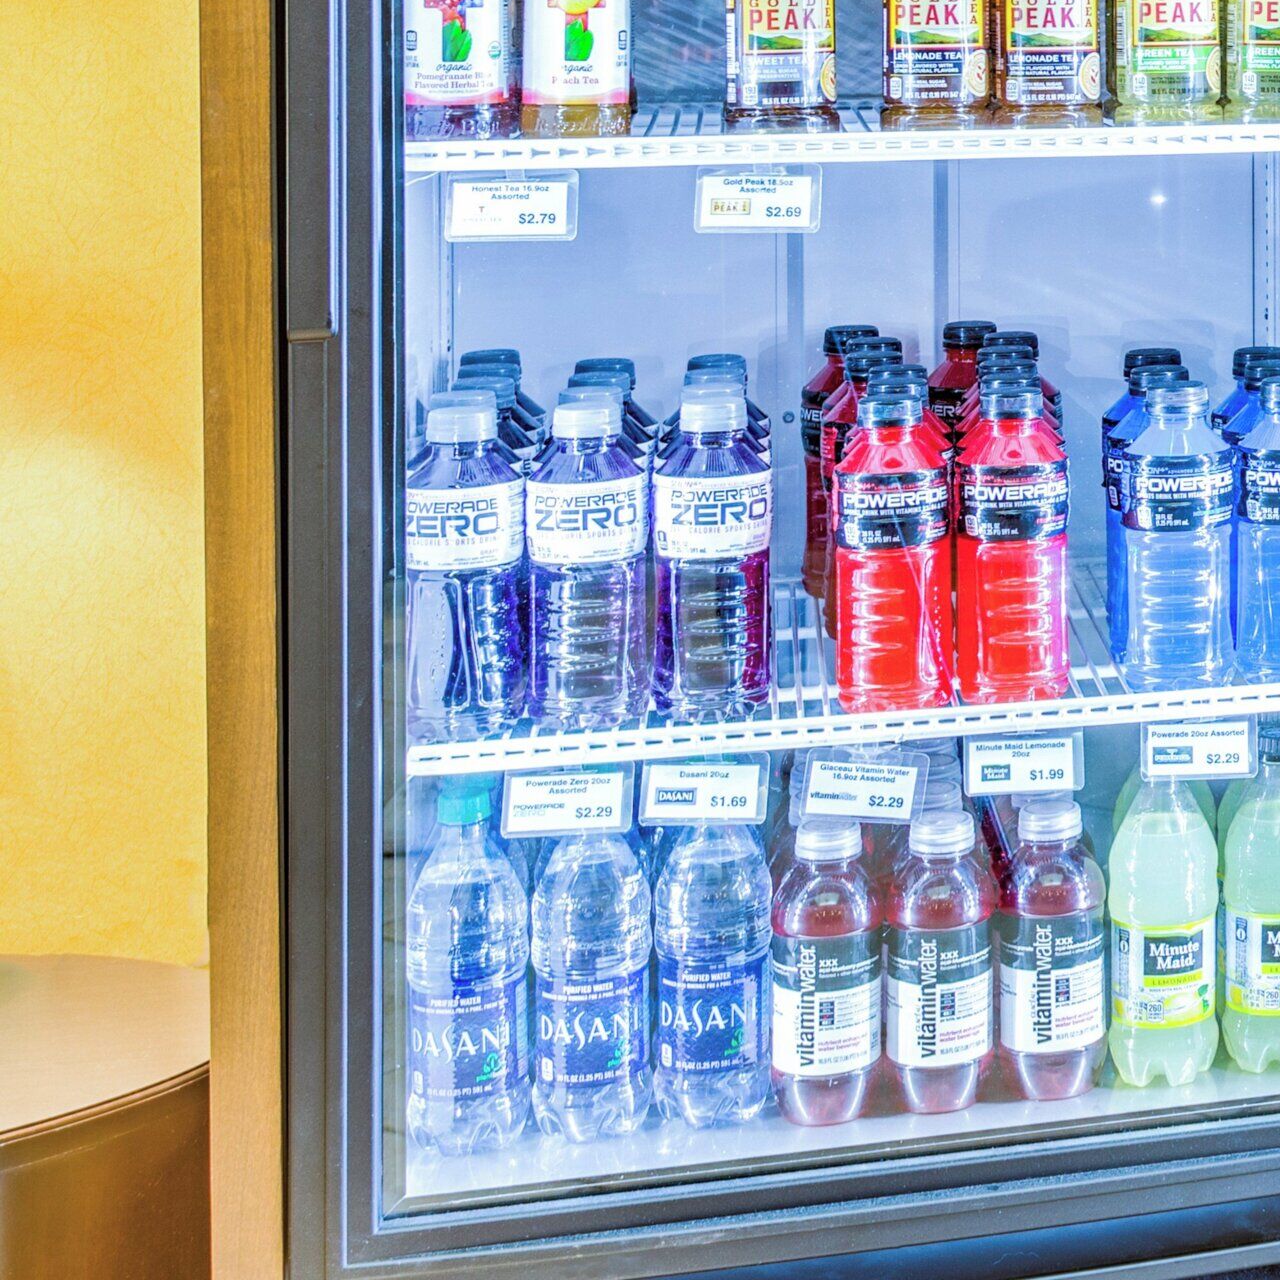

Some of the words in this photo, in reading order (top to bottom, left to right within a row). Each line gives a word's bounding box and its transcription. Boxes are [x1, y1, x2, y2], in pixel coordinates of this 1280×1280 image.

[748, 8, 820, 31] PEAK
[895, 5, 965, 26] PEAK
[1010, 7, 1077, 29] PEAK
[1139, 1, 1205, 23] PEAK
[518, 212, 556, 224] $2.79
[765, 206, 802, 218] $2.69
[964, 480, 1069, 500] POWERADE
[1136, 472, 1234, 493] POWERADE
[535, 491, 637, 508] POWERADE
[843, 485, 949, 509] POWERADE
[535, 503, 638, 532] ZERO
[671, 499, 767, 526] ZERO
[976, 744, 1002, 752] Minute
[1004, 743, 1023, 751] Maid
[1025, 741, 1066, 749] Lemonade
[1206, 753, 1240, 764] $2.29
[1030, 769, 1064, 780] $1.99
[711, 797, 747, 807] $1.69
[868, 796, 904, 808] $2.29
[575, 806, 612, 818] $2.29
[1148, 941, 1200, 958] Minute
[1157, 953, 1195, 969] Maid
